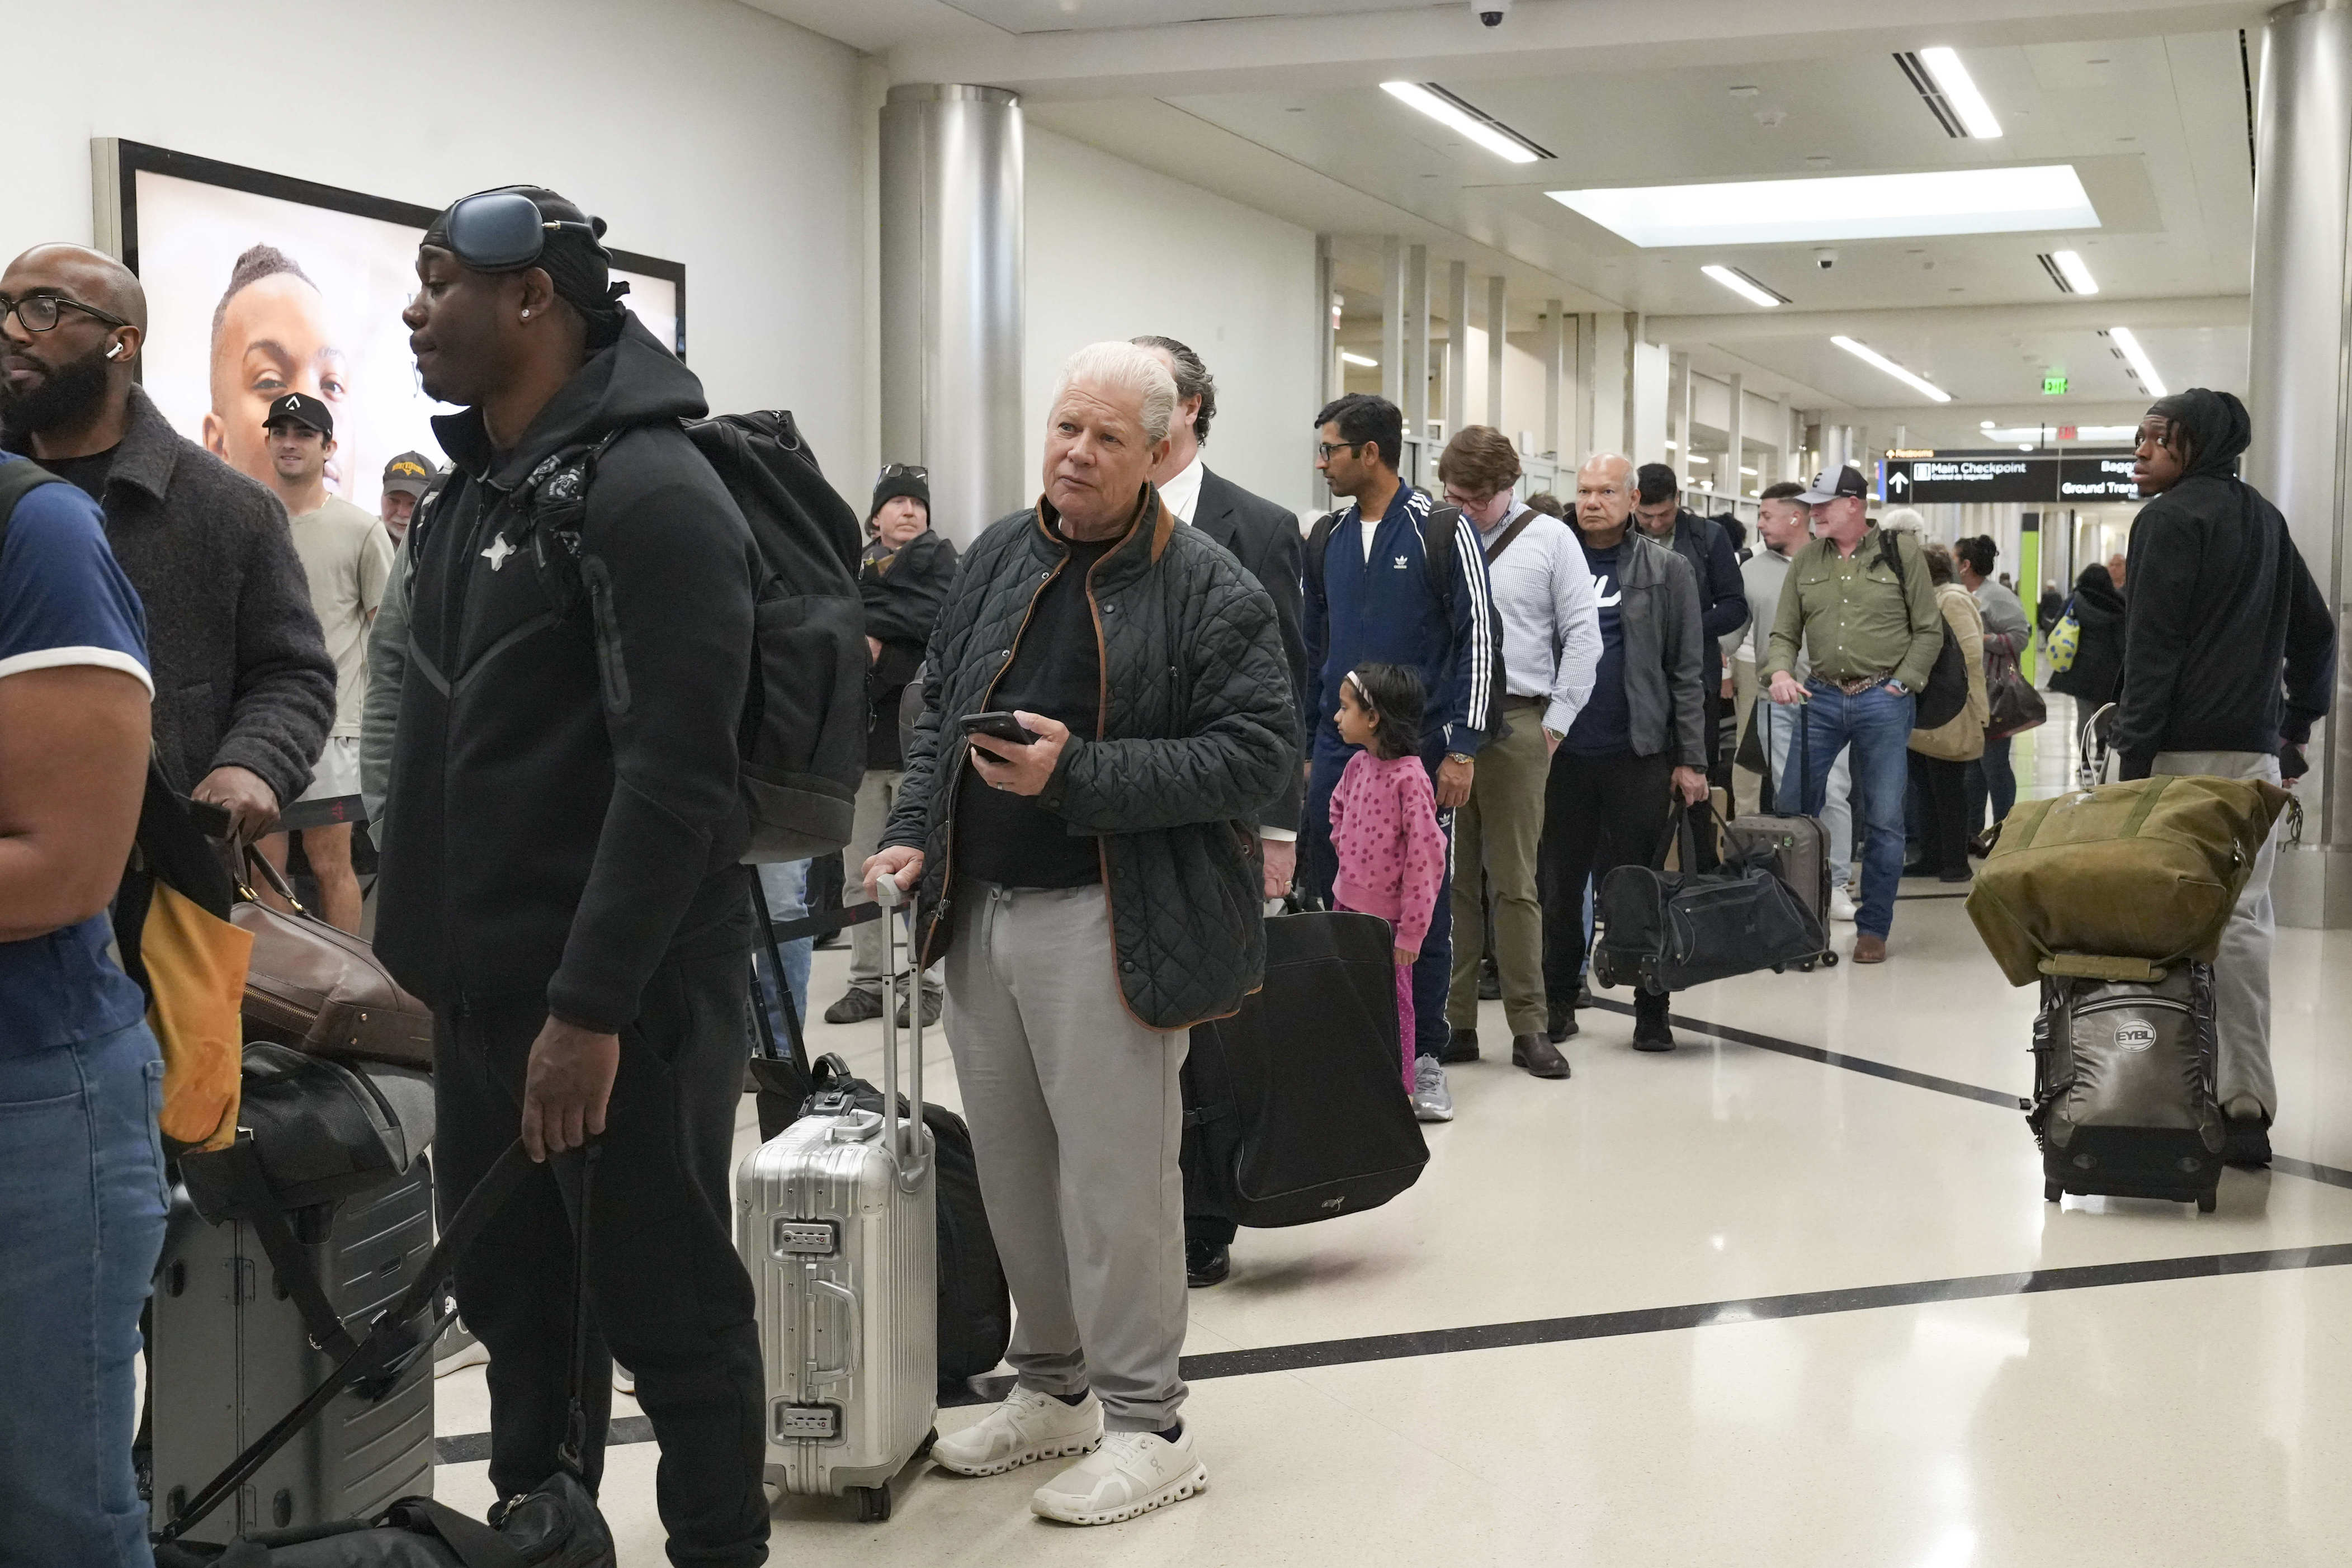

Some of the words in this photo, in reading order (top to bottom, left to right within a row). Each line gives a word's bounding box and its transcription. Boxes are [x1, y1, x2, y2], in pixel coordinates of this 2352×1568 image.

[2059, 426, 2075, 439] EXIT
[1931, 462, 1958, 474] Main
[1961, 462, 2027, 475] Checkpoint
[1812, 473, 1822, 488] E
[2062, 482, 2105, 494] Ground
[2117, 1031, 2153, 1041] EYBL
